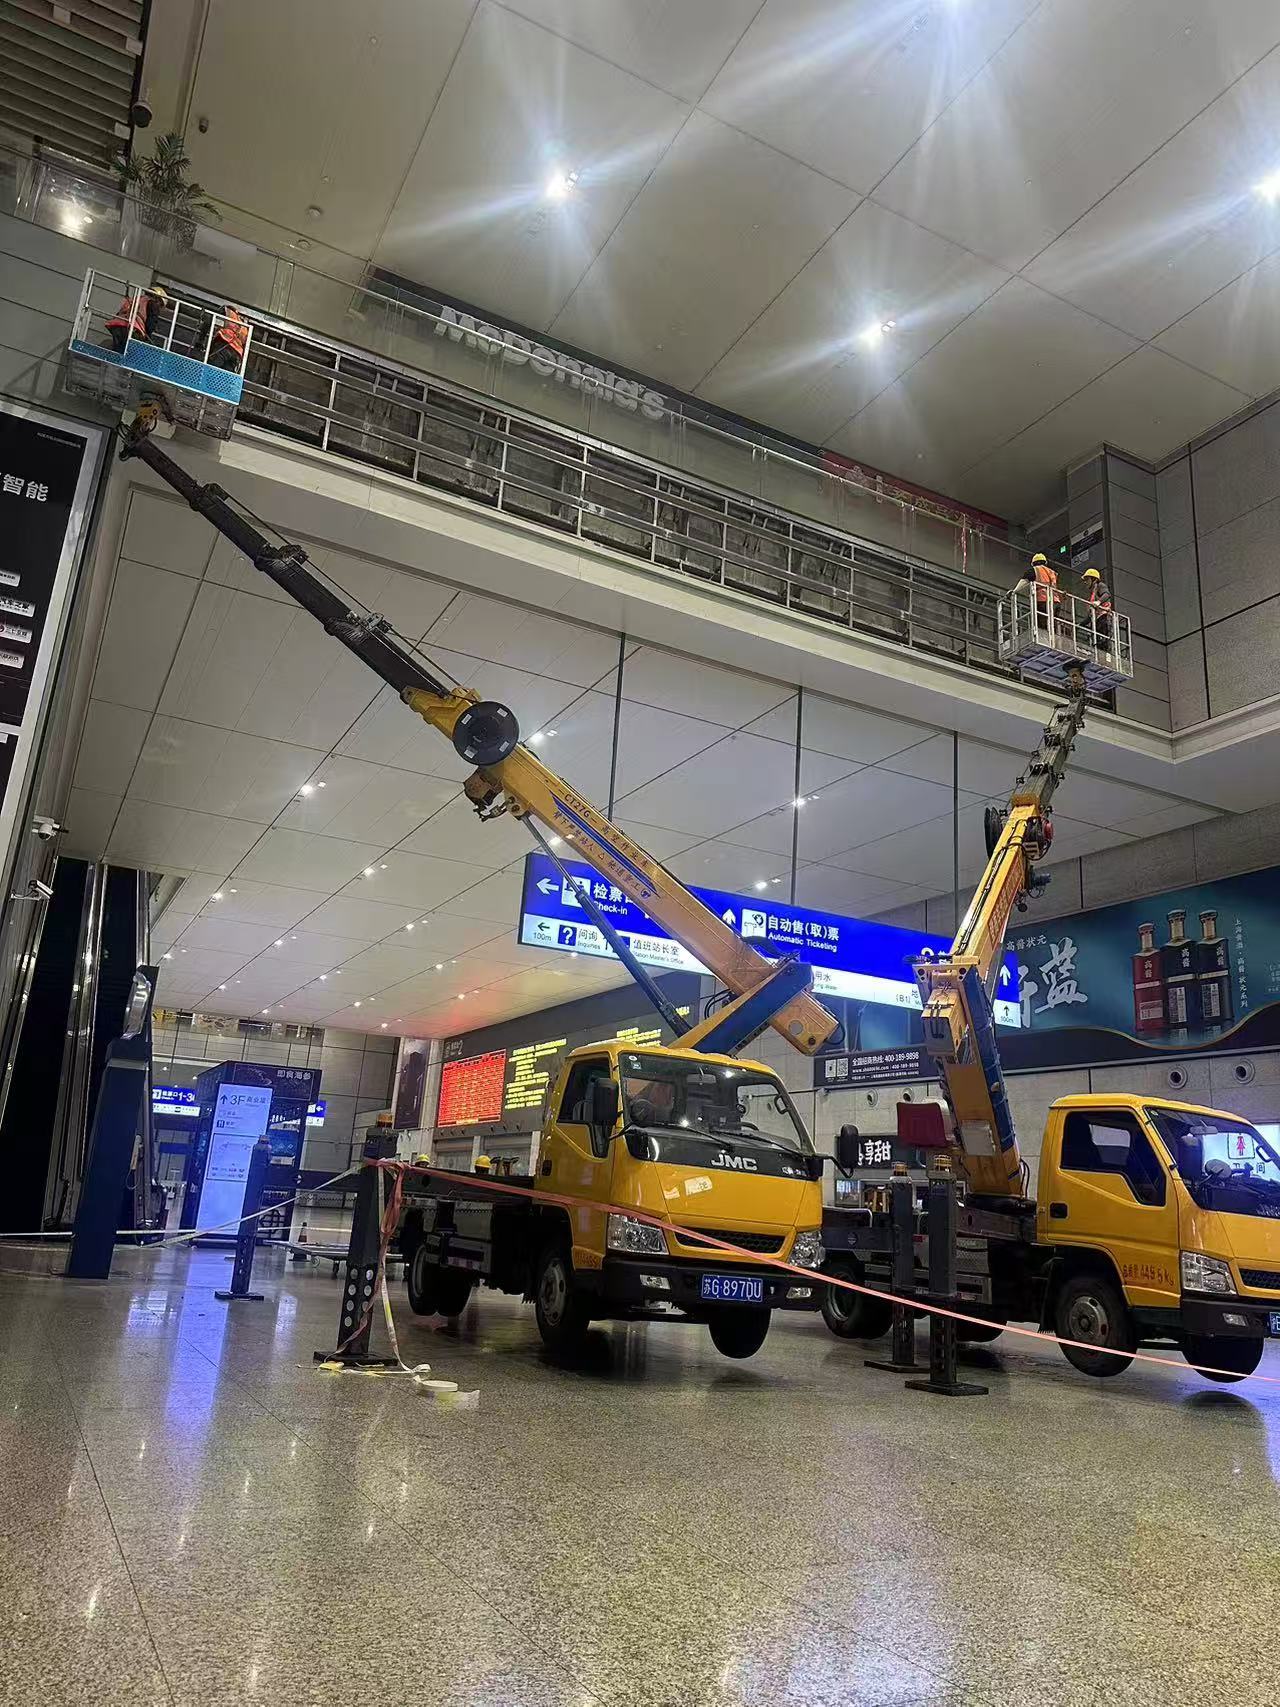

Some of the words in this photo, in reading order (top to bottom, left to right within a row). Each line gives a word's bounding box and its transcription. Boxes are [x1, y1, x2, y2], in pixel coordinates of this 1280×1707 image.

[3, 474, 49, 502] 智能
[564, 793, 591, 818] CT27G
[579, 928, 598, 942] 问询
[768, 915, 840, 941] 自动售(取)票
[768, 932, 804, 945] Automatic
[806, 938, 838, 953] Ticketing
[815, 971, 832, 983] 用水
[230, 1095, 246, 1105] 3F
[711, 1153, 758, 1171] JMC
